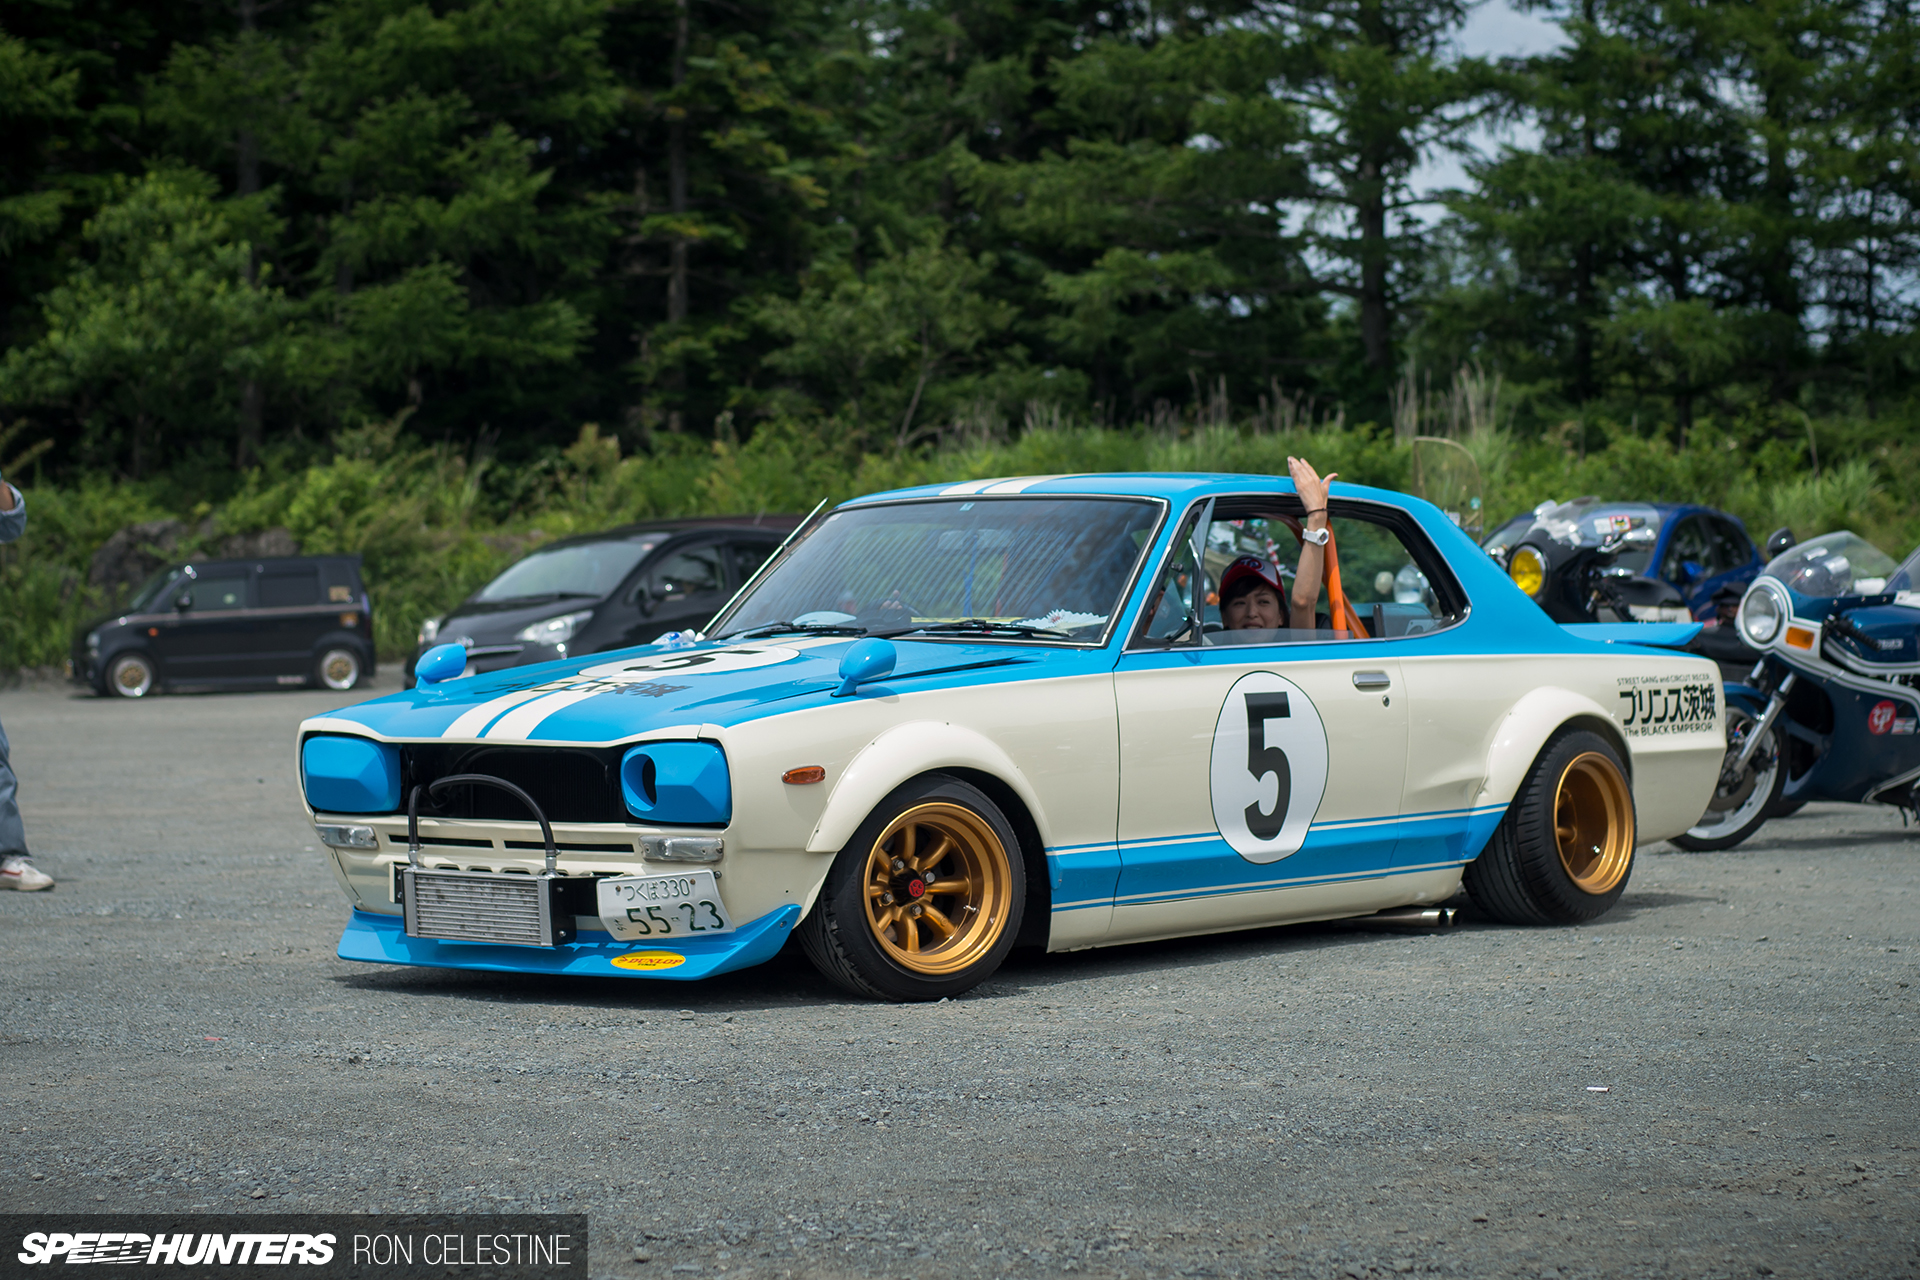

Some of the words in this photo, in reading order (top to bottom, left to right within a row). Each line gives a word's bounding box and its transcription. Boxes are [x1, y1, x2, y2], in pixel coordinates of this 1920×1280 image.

[623, 650, 765, 672] 5
[1617, 677, 1640, 686] STREET
[1641, 675, 1658, 684] GANG
[1619, 683, 1717, 726] プリンス茨城
[1623, 728, 1639, 738] The
[1641, 725, 1669, 737] BLACK
[1244, 691, 1291, 841] 5
[628, 957, 683, 965] DUNLOP
